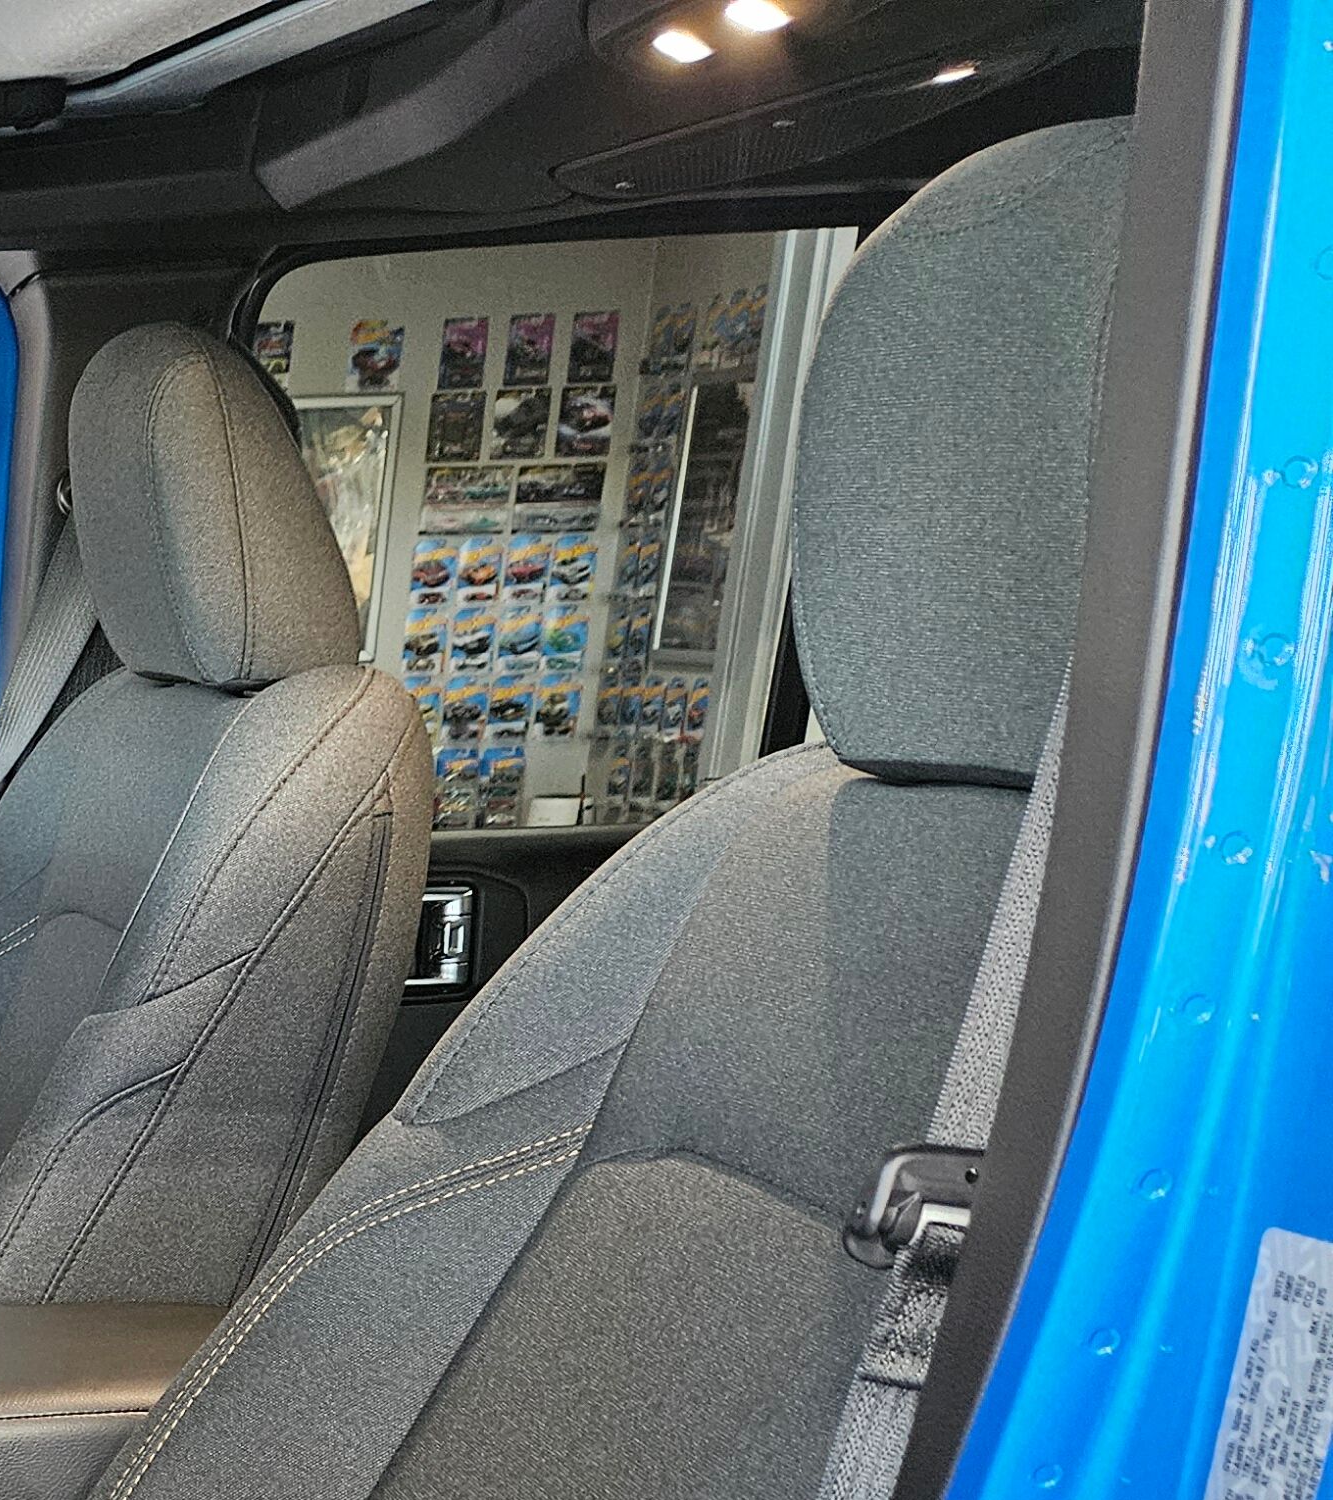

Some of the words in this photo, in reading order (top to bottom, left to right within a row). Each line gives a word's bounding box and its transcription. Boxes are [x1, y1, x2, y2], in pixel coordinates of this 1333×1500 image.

[1272, 1270, 1286, 1299] WITH
[1292, 1274, 1307, 1305] TIRES
[1303, 1280, 1316, 1308] COLD
[1296, 1397, 1314, 1444] FEDERAL
[1308, 1357, 1323, 1394] MOTOR
[1304, 1416, 1321, 1453] EFFECT
[1315, 1397, 1325, 1412] ON
[1320, 1374, 1330, 1392] THE
